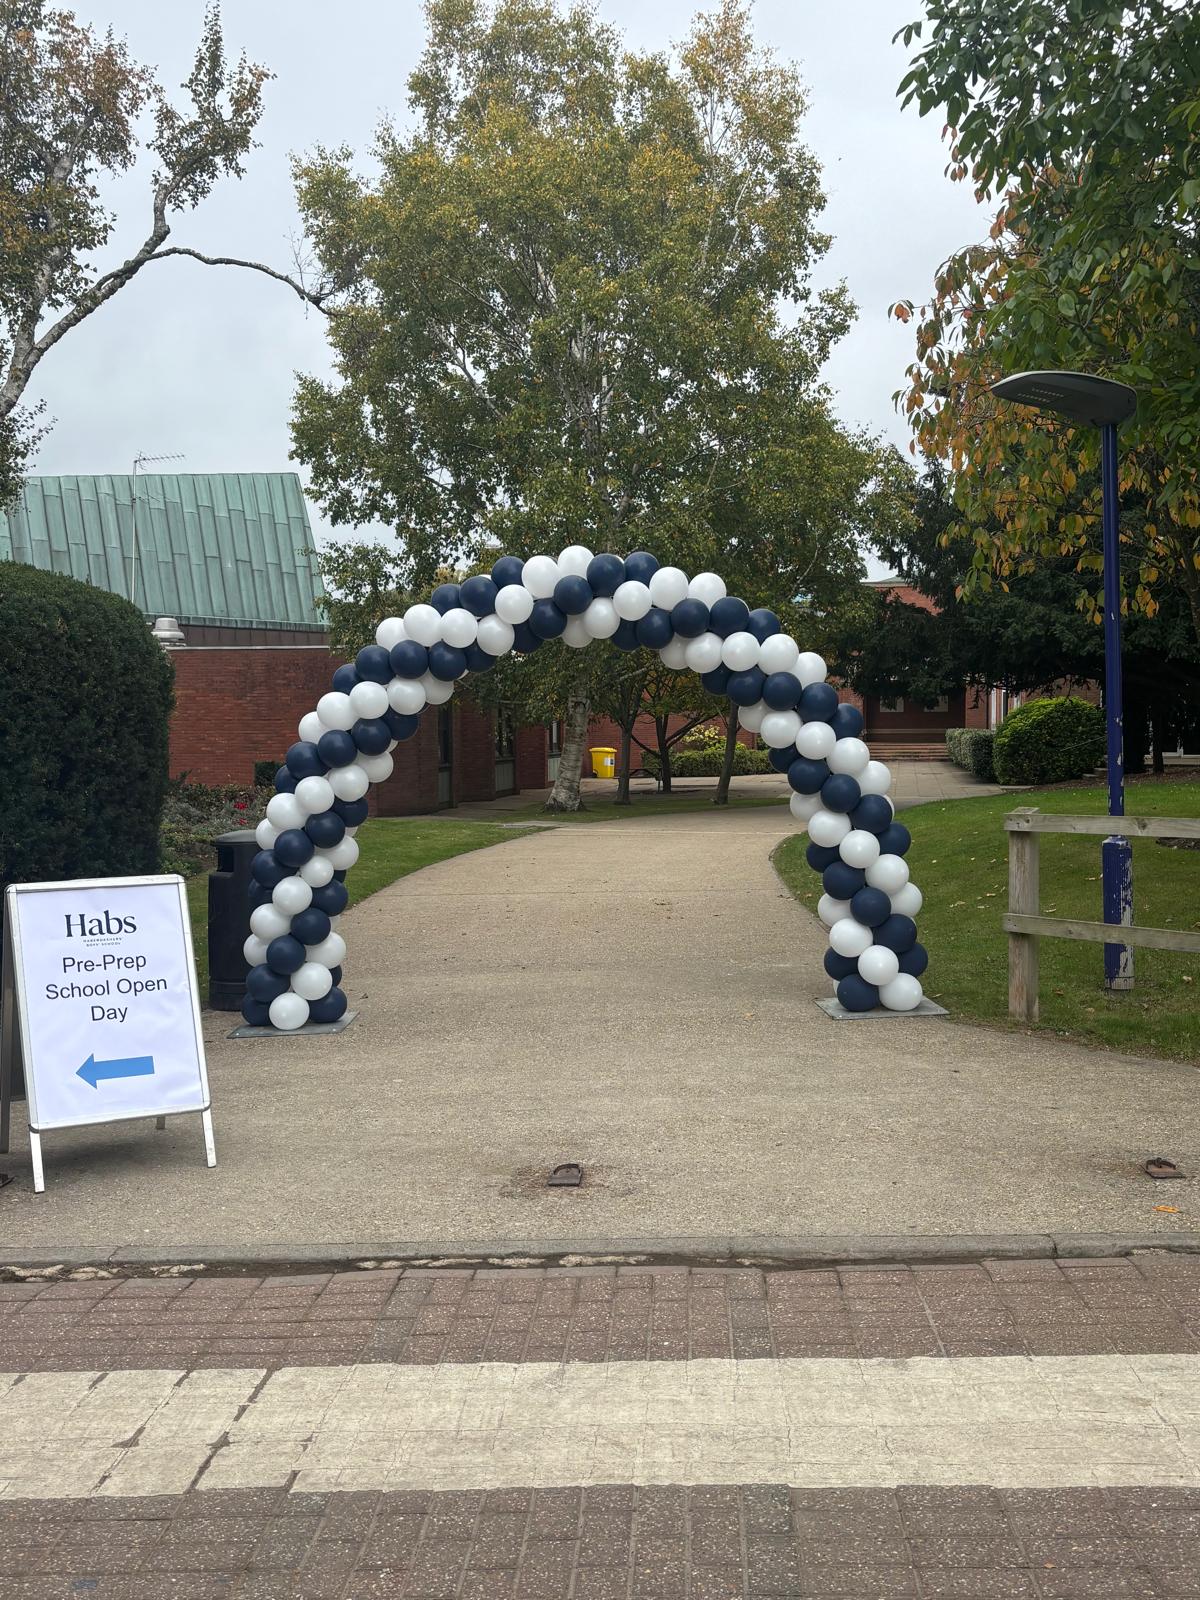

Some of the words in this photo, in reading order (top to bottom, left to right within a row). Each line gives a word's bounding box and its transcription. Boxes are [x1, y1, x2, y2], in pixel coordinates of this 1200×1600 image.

[65, 910, 137, 938] Habs
[62, 954, 147, 973] Pre-Prep
[45, 979, 110, 1000] School
[116, 978, 168, 997] Open
[90, 1005, 128, 1023] Day
